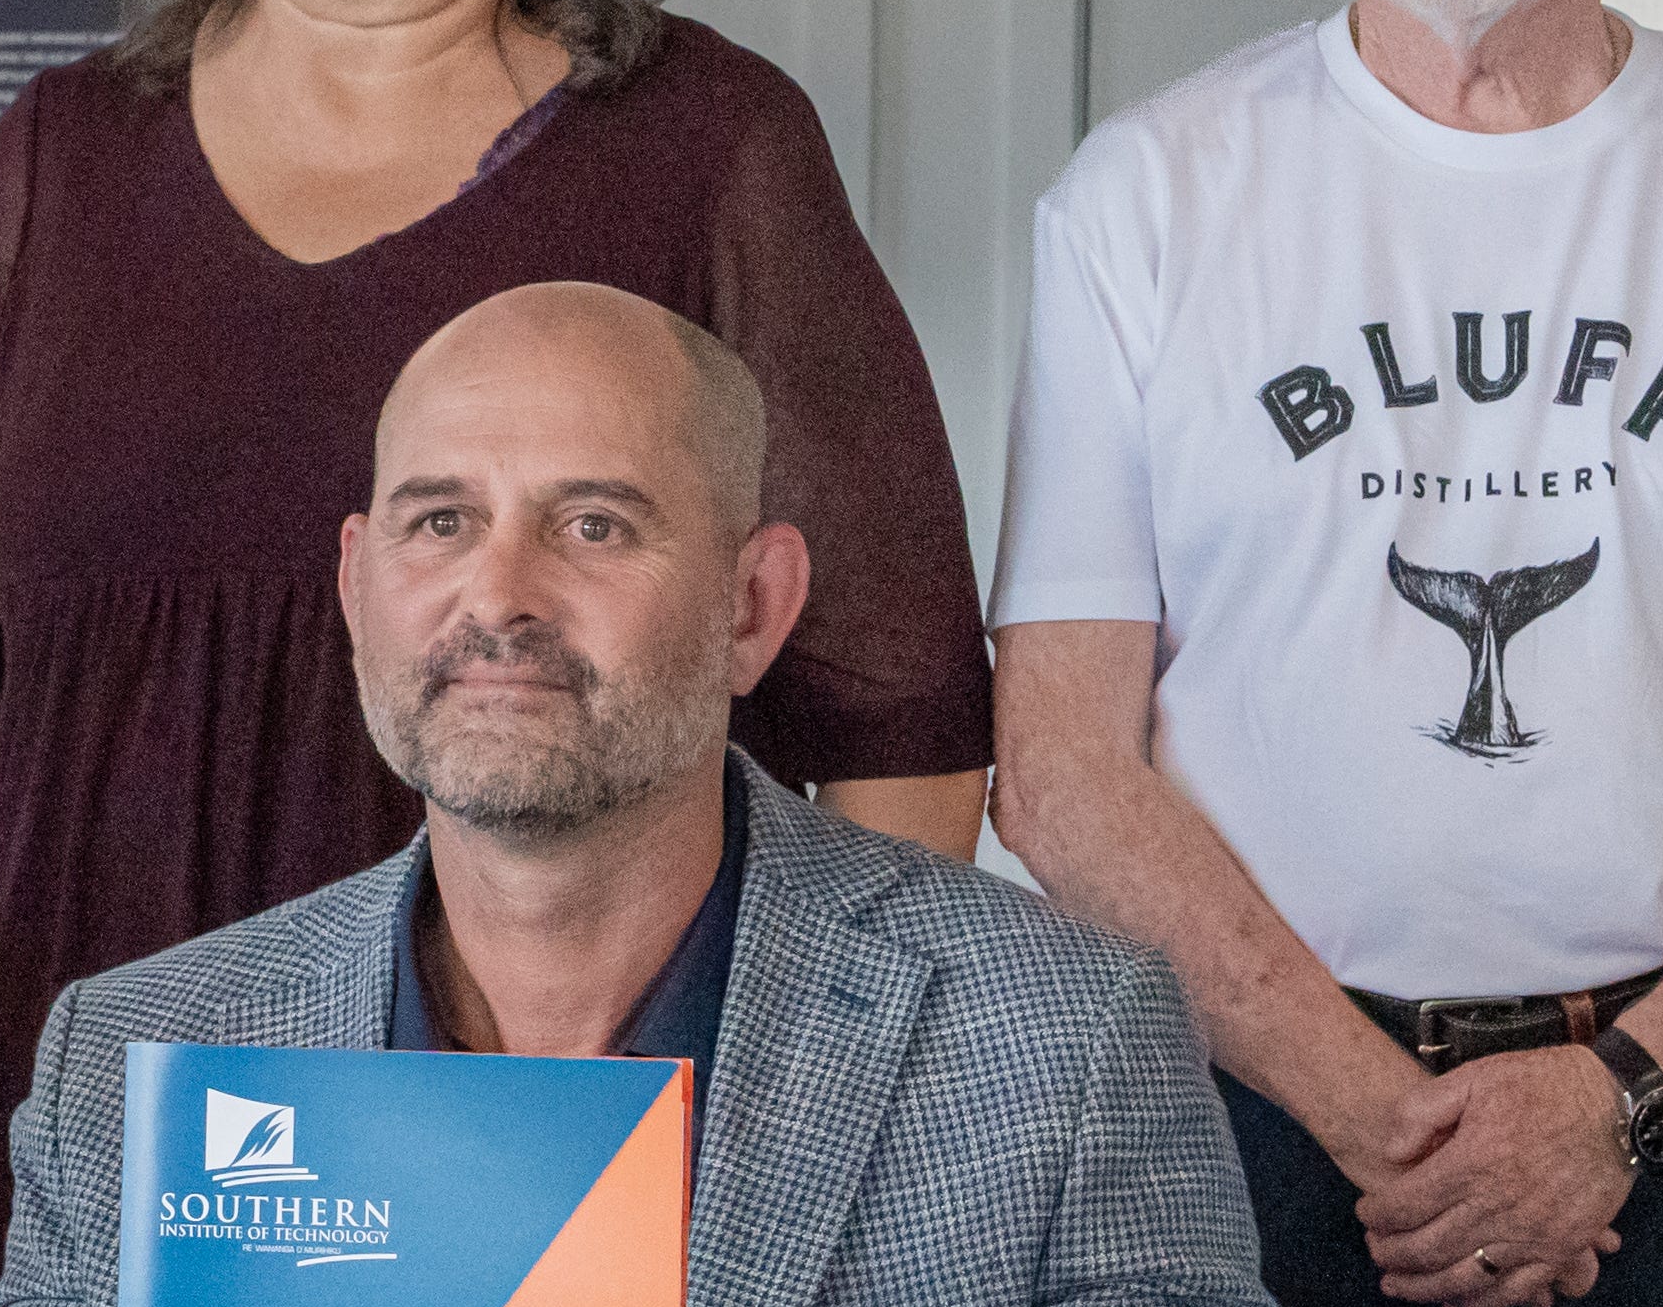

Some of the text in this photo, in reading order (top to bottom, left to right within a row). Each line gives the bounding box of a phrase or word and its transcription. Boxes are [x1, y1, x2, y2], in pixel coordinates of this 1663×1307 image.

[1361, 460, 1617, 503] DISTILLERY
[160, 1192, 391, 1228] SOUTHERN
[159, 1223, 390, 1244] INSTITUTE OF TECHNOLOGY
